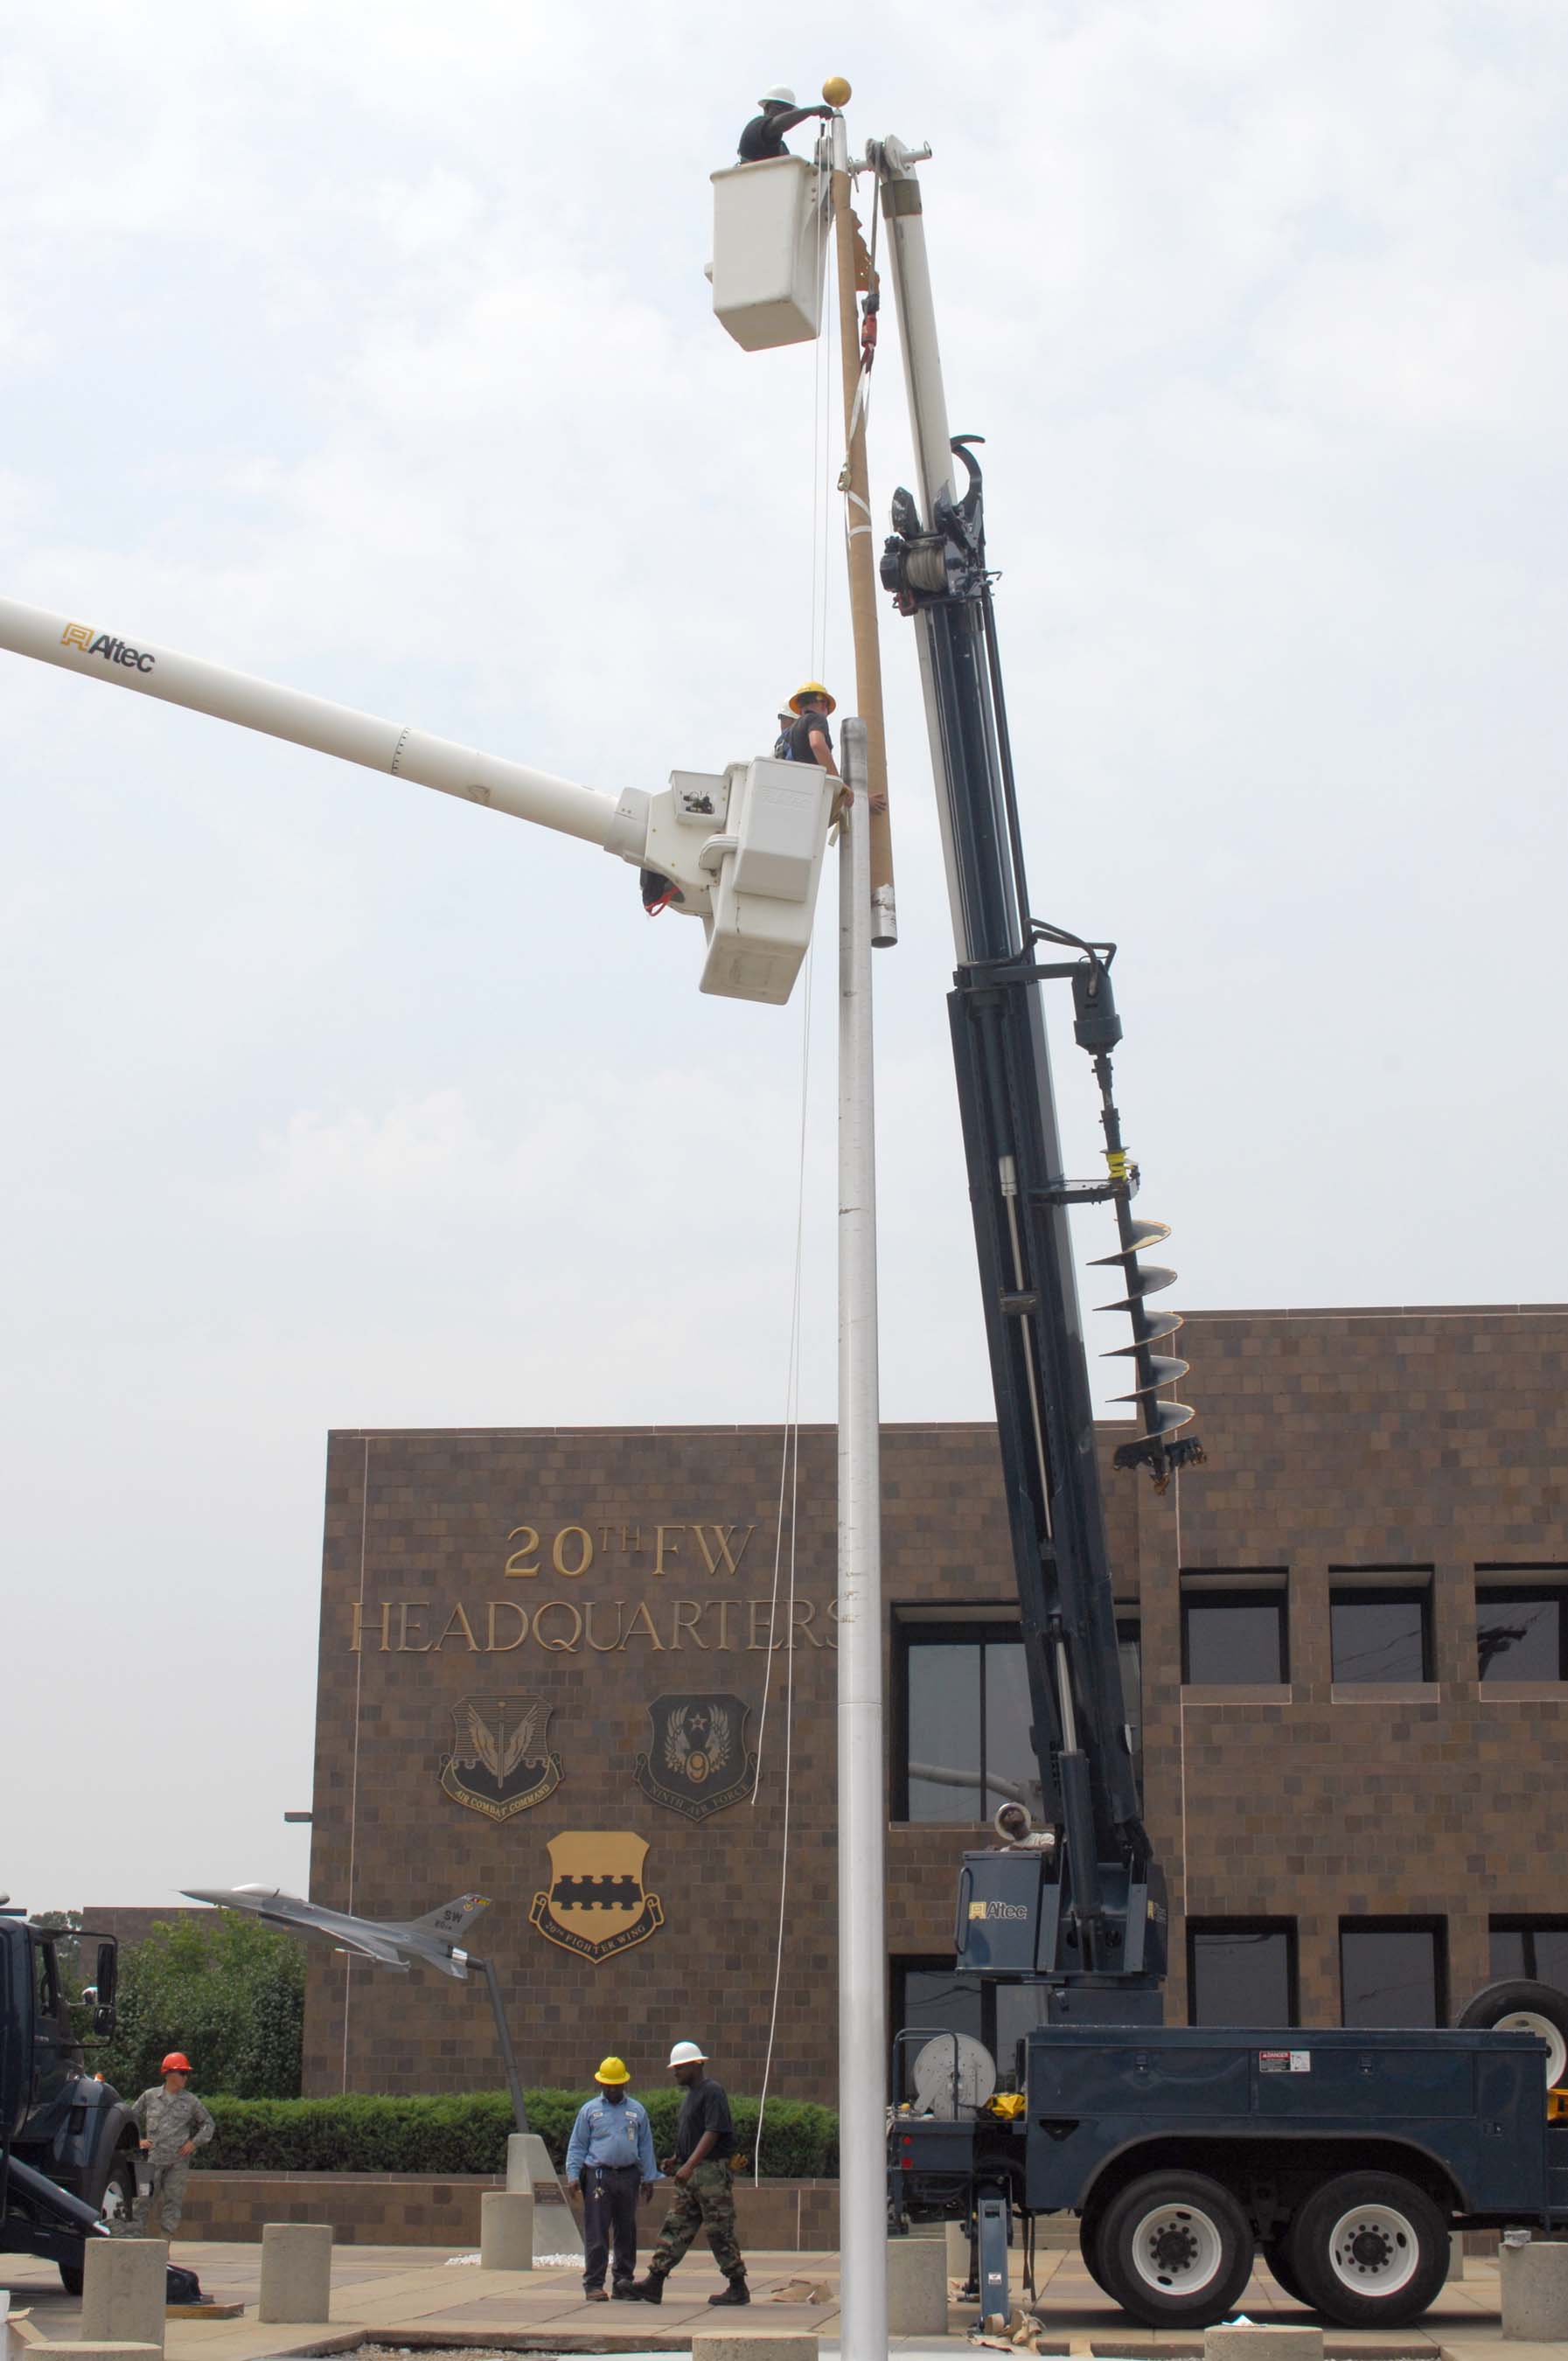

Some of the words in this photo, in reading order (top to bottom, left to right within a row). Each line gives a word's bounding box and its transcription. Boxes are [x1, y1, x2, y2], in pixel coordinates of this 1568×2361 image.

[88, 634, 155, 672] Altec
[505, 1525, 651, 1577] 20TH
[652, 1525, 759, 1576] FW
[455, 1791, 470, 1803] AIR
[470, 1797, 508, 1817] COMBAT
[509, 1784, 551, 1812] COMMAND
[651, 1785, 685, 1808] NINTH
[713, 1783, 749, 1807] FORCE
[443, 1910, 463, 1924] SW
[986, 1901, 1028, 1919] Altec
[565, 1933, 617, 1955] FIGHTER
[617, 1924, 646, 1944] WING
